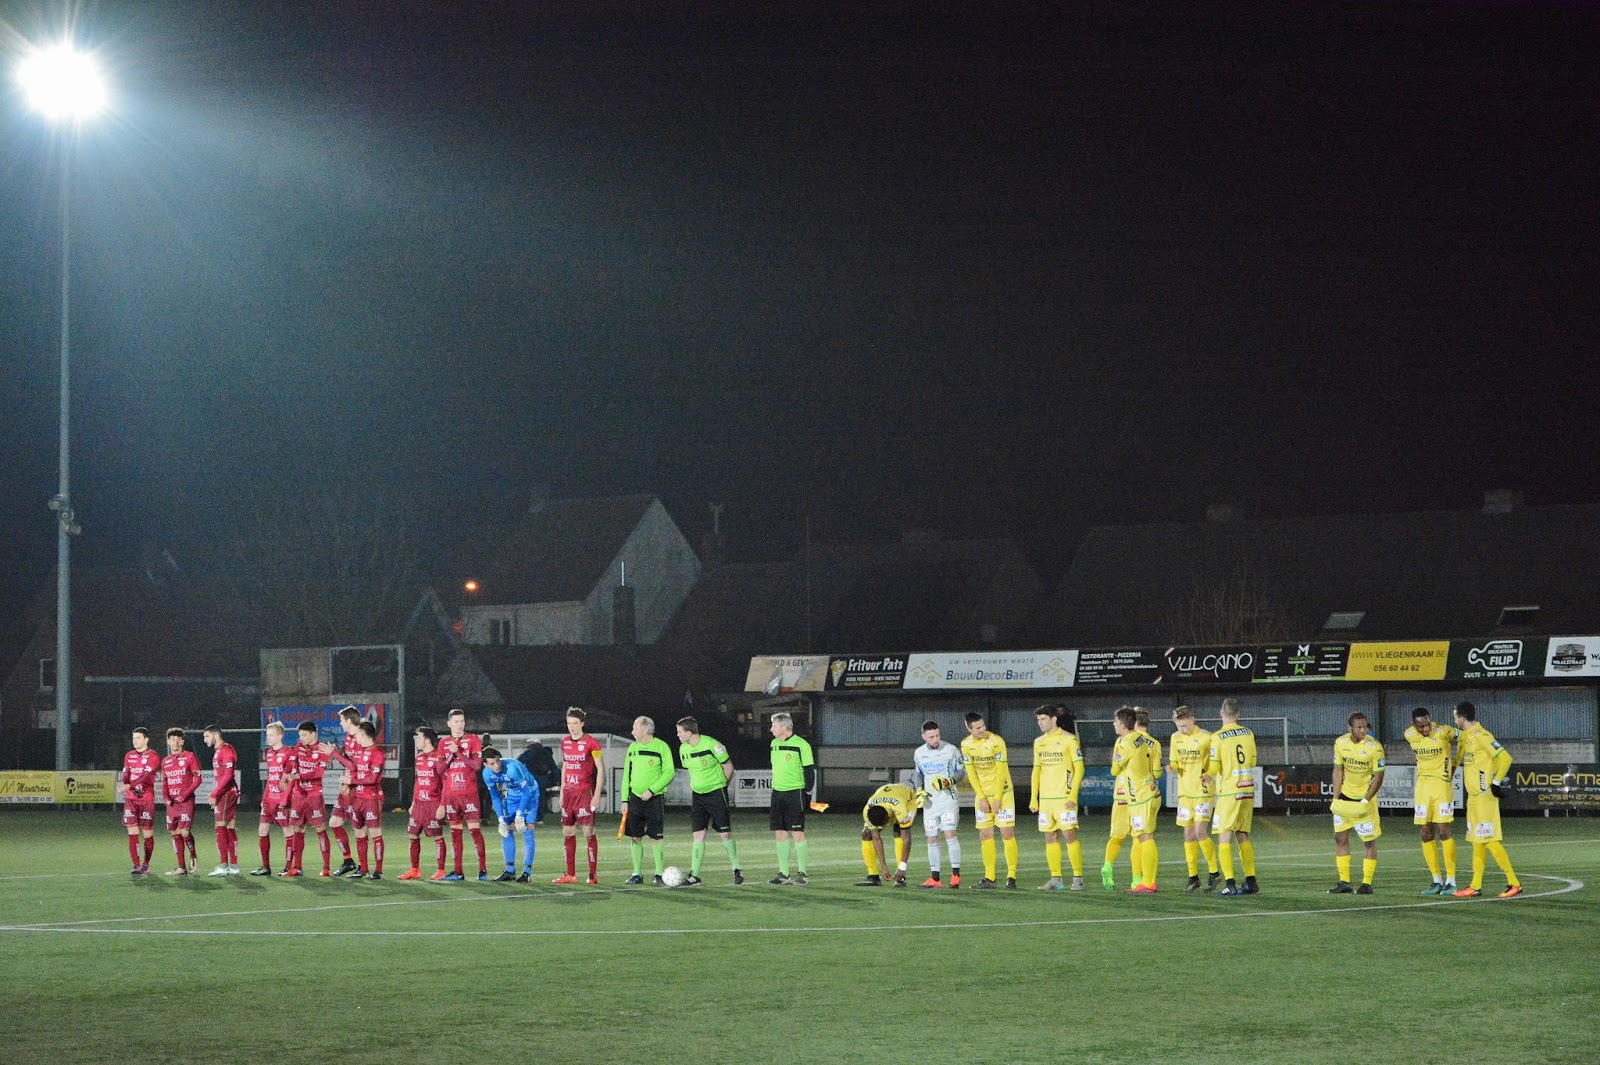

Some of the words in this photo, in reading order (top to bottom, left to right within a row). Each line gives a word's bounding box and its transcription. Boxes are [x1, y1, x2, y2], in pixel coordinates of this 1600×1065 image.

[848, 658, 881, 671] Frituur
[883, 657, 904, 670] Pats
[1168, 652, 1253, 678] VULCANO
[1490, 655, 1514, 666] FILIP
[946, 669, 1034, 680] BouwDecorBaert
[1235, 744, 1245, 764] 6
[450, 773, 466, 783] TAL
